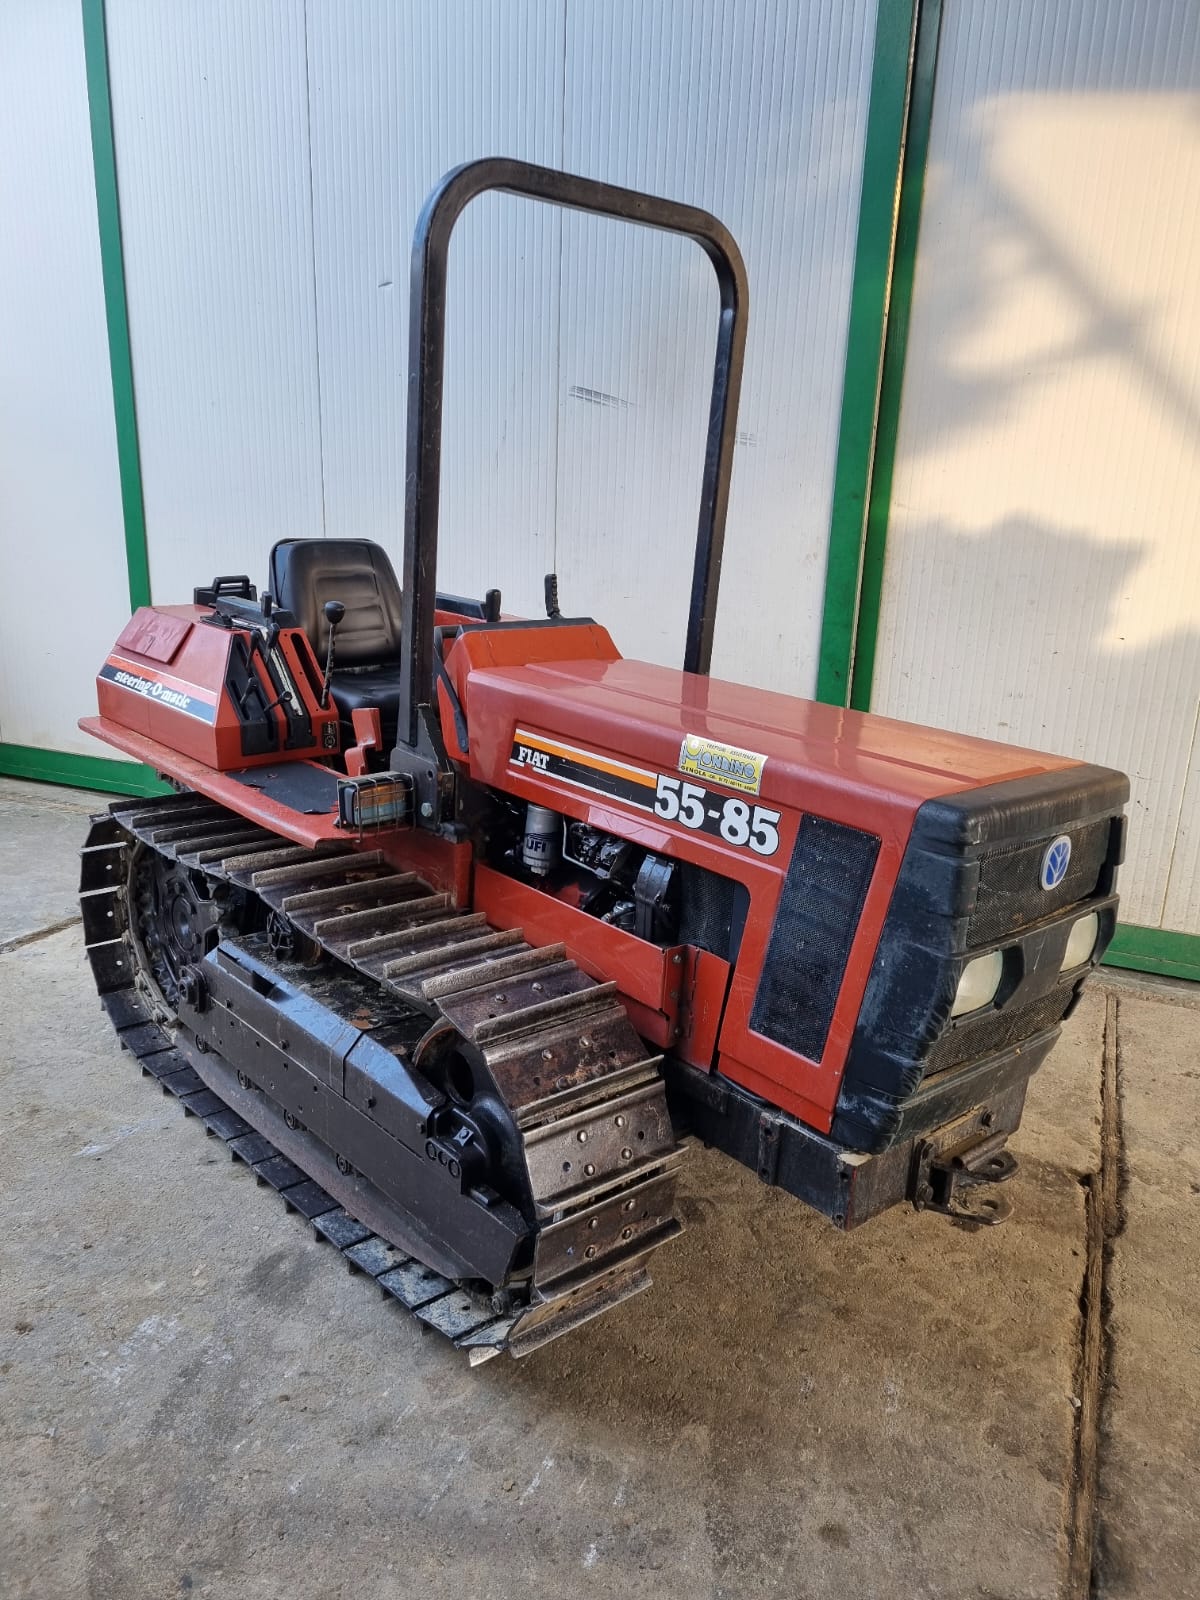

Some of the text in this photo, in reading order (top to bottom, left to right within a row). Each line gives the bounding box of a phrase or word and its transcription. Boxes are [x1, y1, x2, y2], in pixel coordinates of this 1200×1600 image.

[518, 746, 549, 769] FIAT
[680, 765, 707, 777] GENOLA
[654, 773, 782, 856] 55-85
[526, 839, 547, 853] UFI
